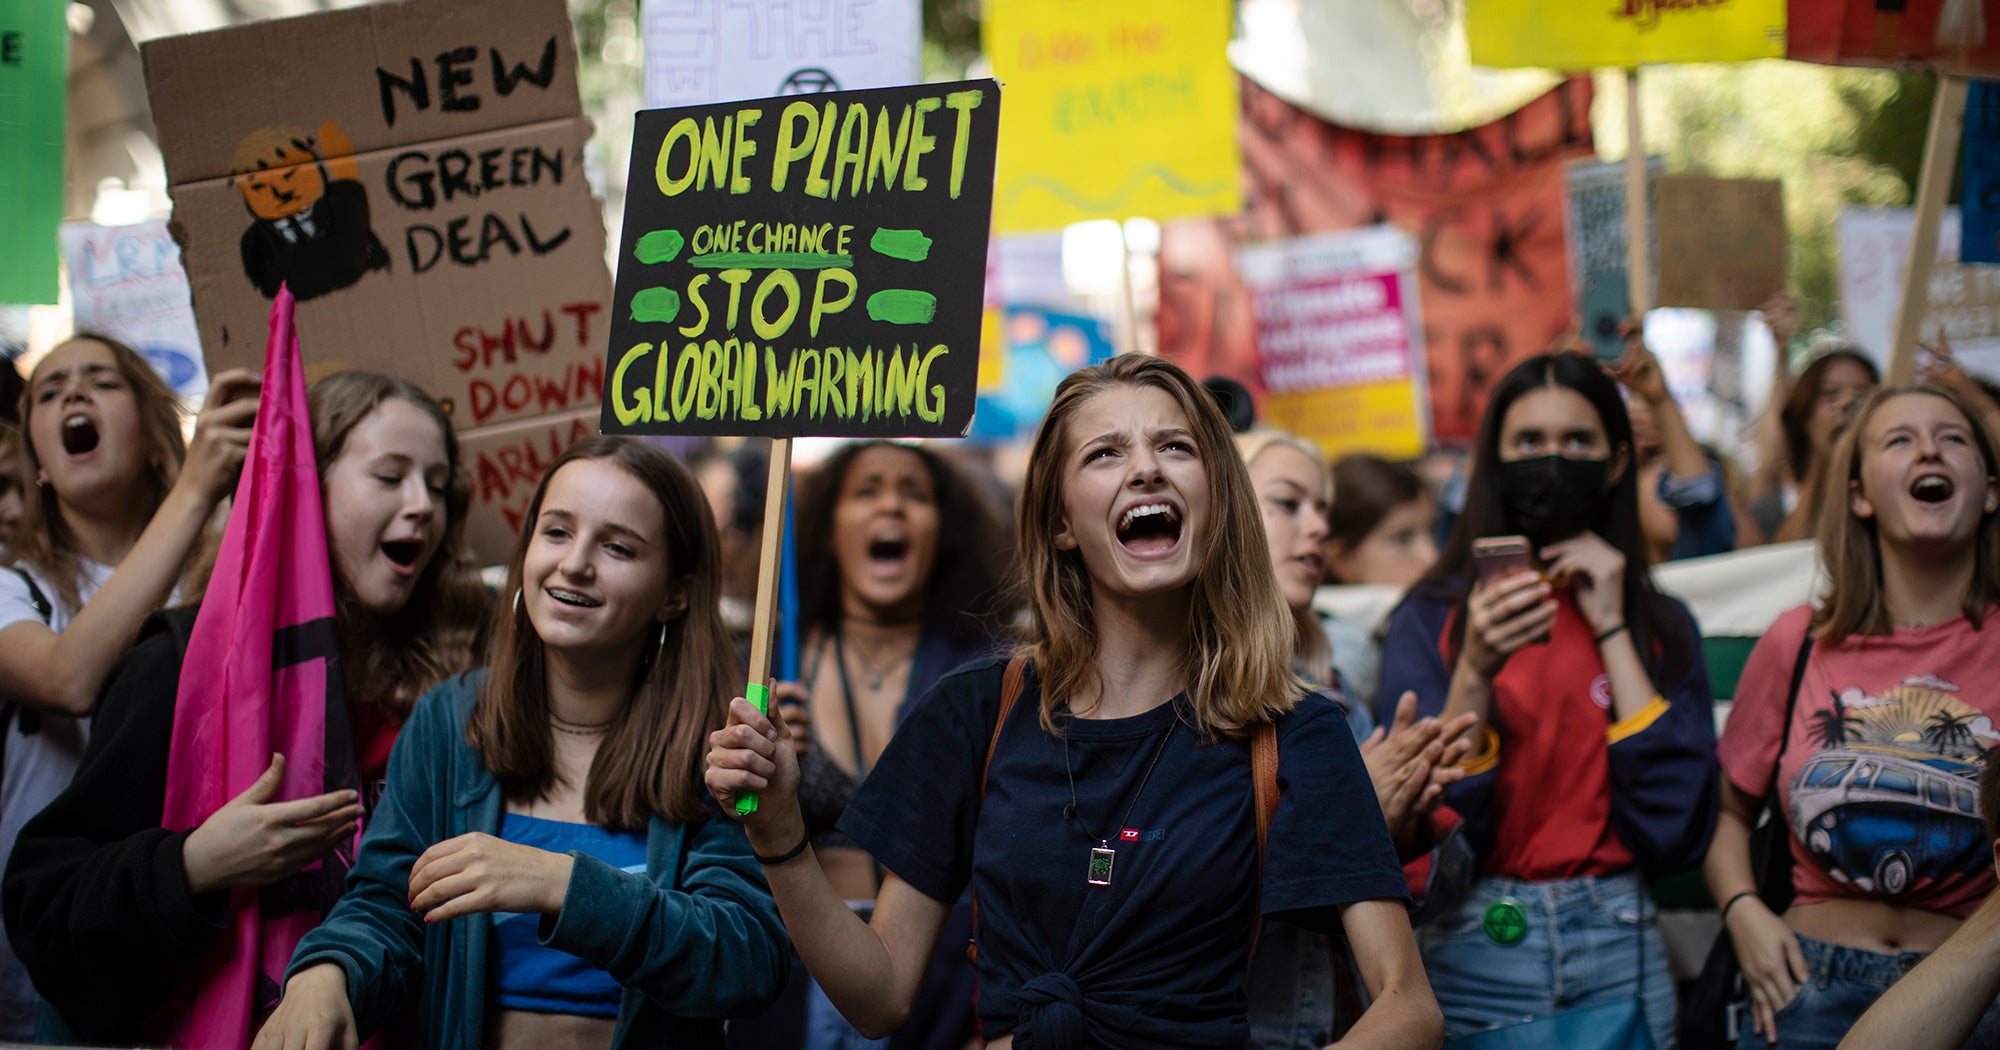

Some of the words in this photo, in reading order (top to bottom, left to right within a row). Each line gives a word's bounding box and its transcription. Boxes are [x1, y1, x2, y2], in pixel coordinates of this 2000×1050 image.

[376, 35, 557, 126] NEW
[386, 146, 564, 210] GREEN
[655, 109, 762, 197] ONE
[771, 89, 983, 201] PLANET
[404, 212, 571, 274] DEAL
[692, 220, 746, 255] ONE
[747, 221, 855, 255] CHANCE
[453, 302, 601, 373] SHUT
[678, 267, 858, 340] STOP
[469, 356, 604, 424] DOWN
[611, 337, 763, 427] GLOBAL
[764, 341, 949, 426] WARMING
